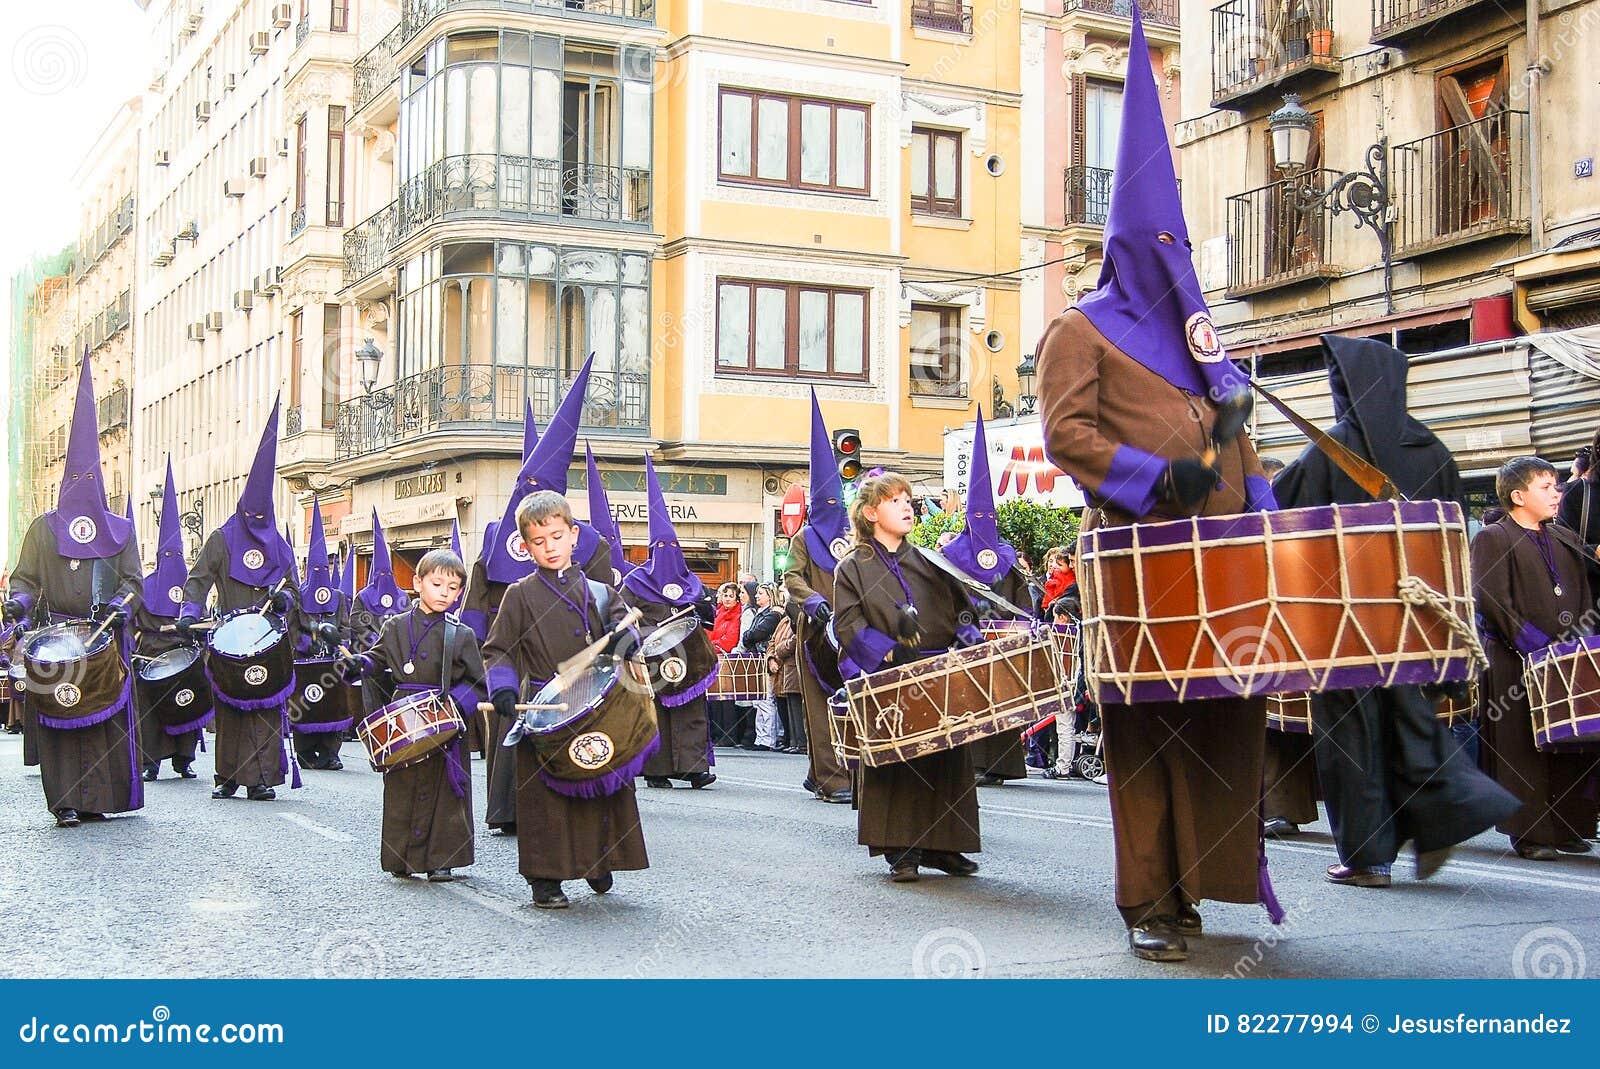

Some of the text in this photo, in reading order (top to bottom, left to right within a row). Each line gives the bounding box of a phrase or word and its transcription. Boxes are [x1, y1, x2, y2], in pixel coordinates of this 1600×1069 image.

[1575, 161, 1589, 176] 52
[957, 454, 967, 476] 808
[396, 474, 442, 498] LOS ALPES
[633, 471, 717, 493] APES
[957, 481, 967, 495] 45
